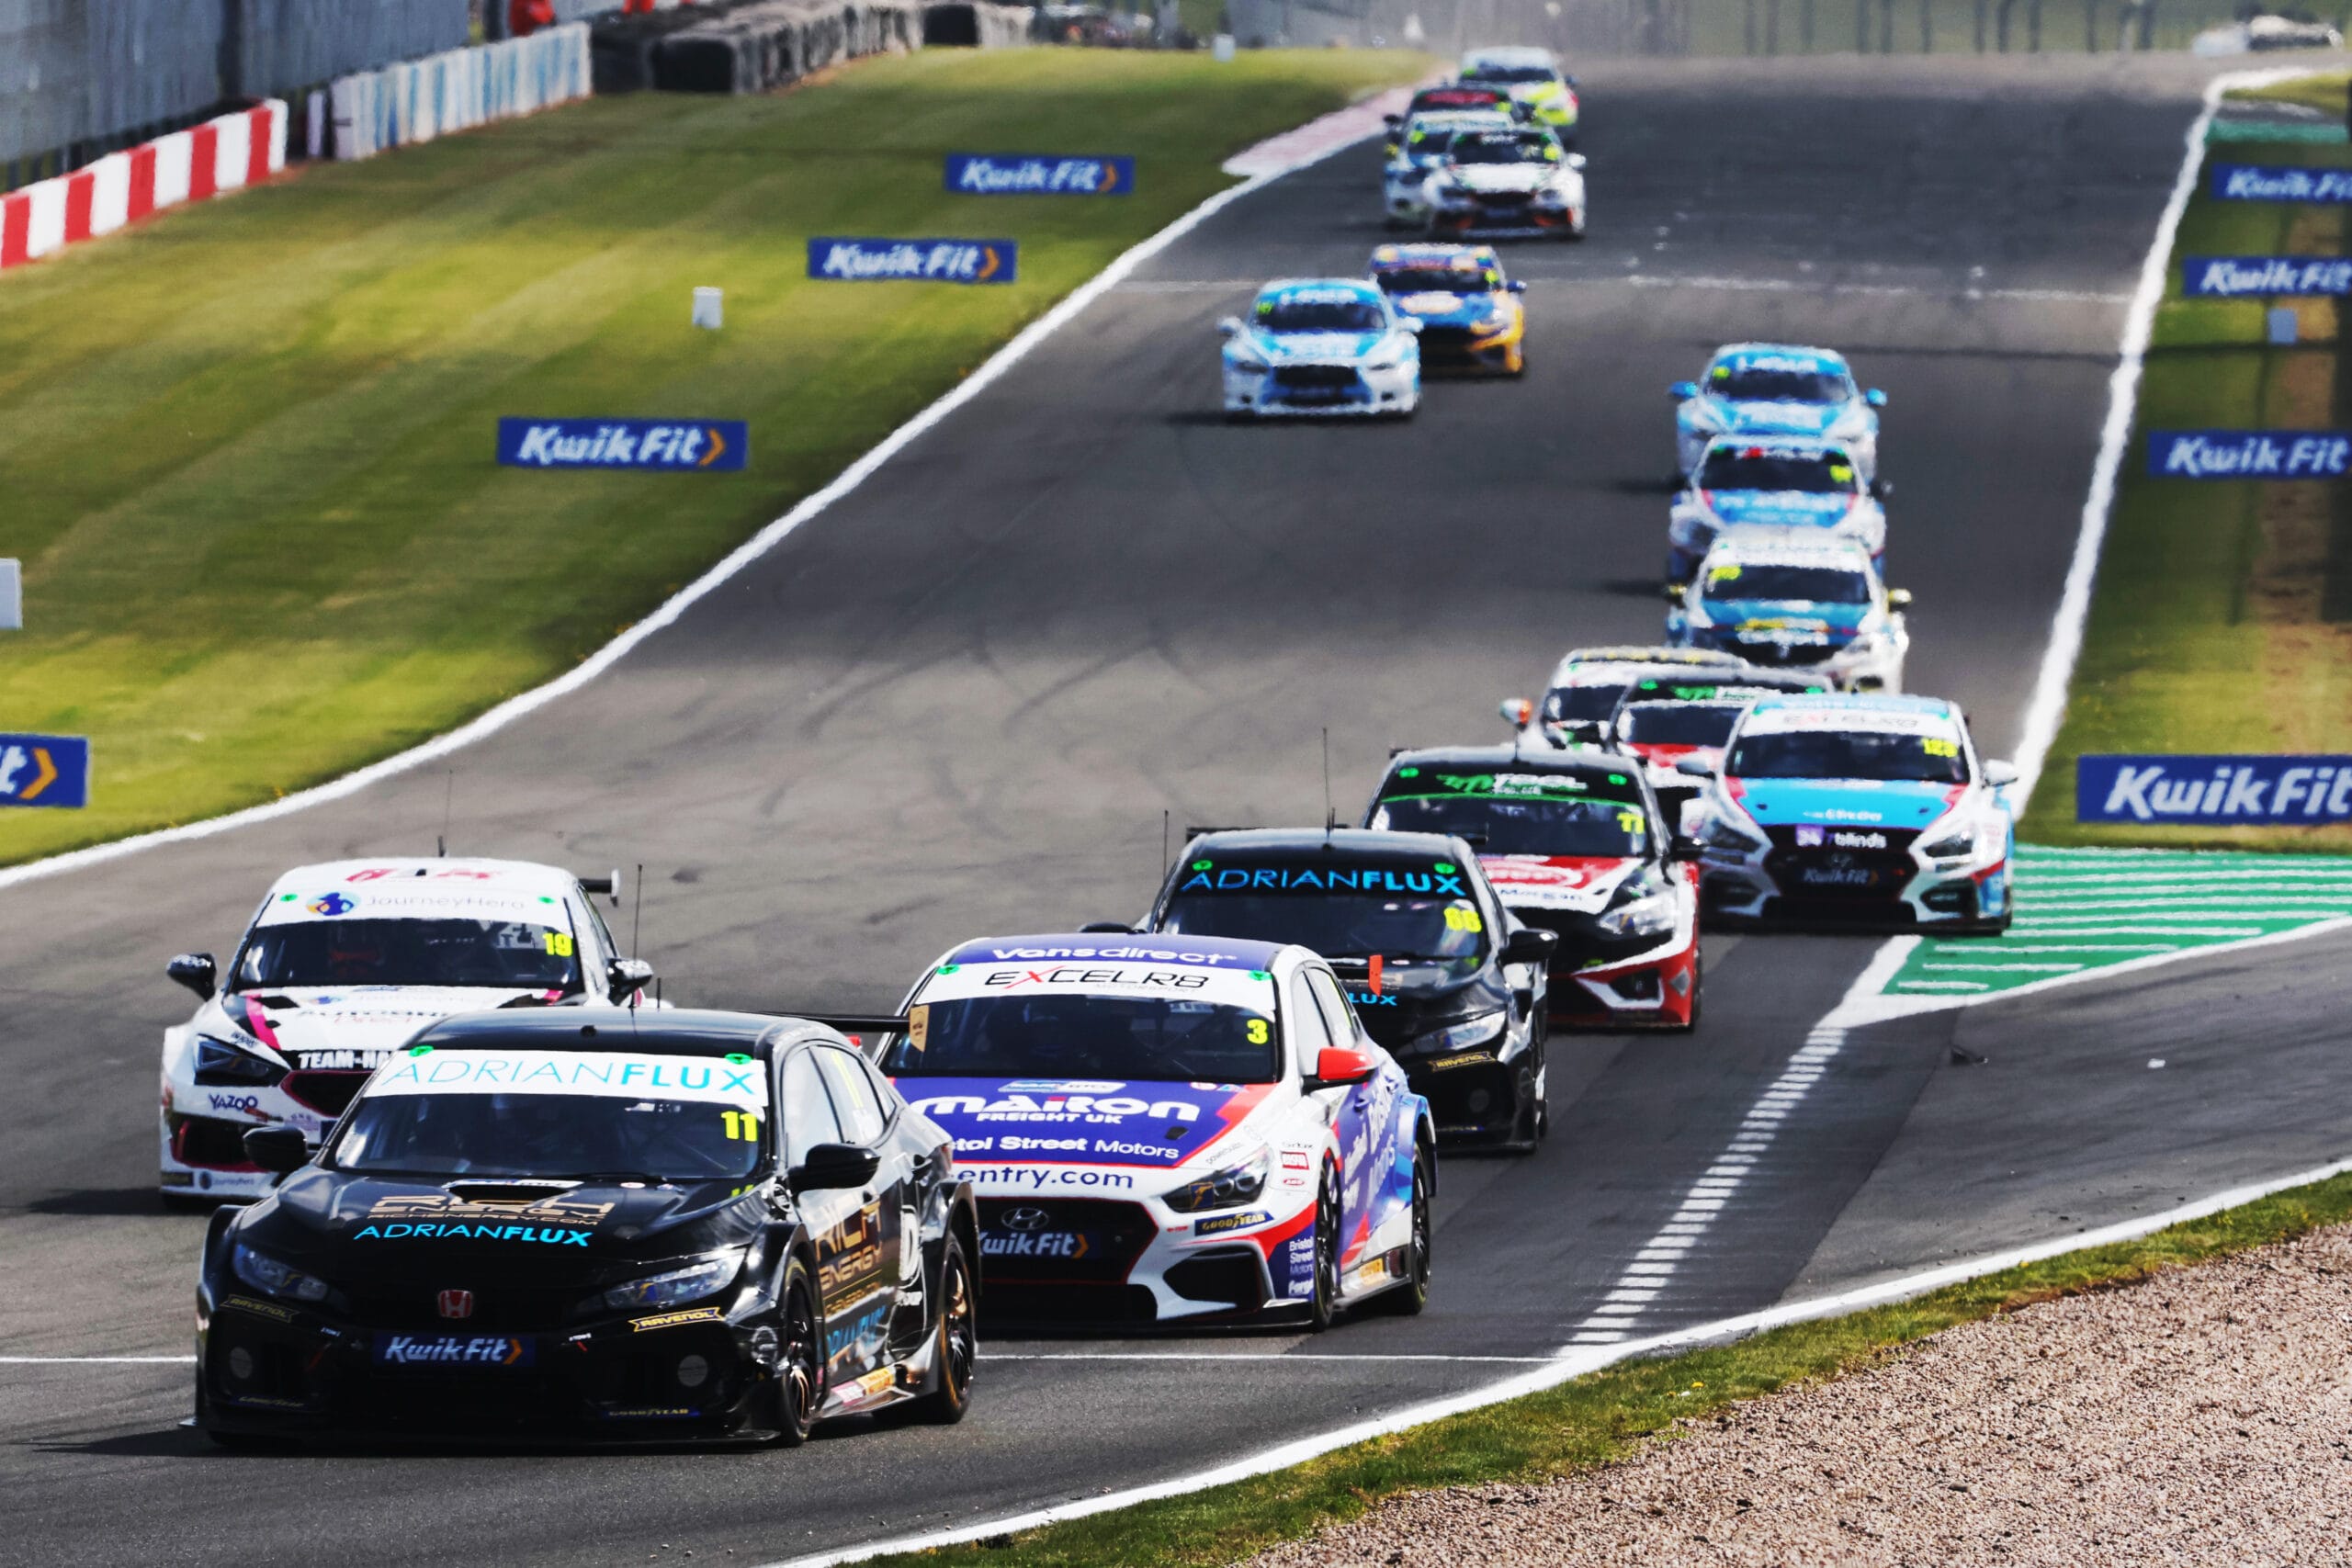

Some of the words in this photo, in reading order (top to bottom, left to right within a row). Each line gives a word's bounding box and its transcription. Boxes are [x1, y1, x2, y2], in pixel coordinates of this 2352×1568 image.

[517, 425, 636, 465] Kwik
[638, 426, 702, 463] Fit
[2165, 435, 2283, 477] Kwik
[2286, 438, 2348, 473] Fit
[2104, 765, 2269, 819] Kwik
[2269, 766, 2352, 815] Fit
[542, 932, 573, 957] 19
[984, 964, 1210, 990] EXCELR8
[1246, 1019, 1269, 1045] 3
[298, 1050, 393, 1070] TEAM-HA
[381, 1059, 755, 1096] ADRIANFLUX
[209, 1093, 260, 1111] YAZOO
[721, 1111, 758, 1142] 11
[976, 1111, 1076, 1122] FREIGHT
[1082, 1113, 1123, 1124] UK
[999, 1137, 1088, 1151] Street
[1094, 1141, 1180, 1158] Motors
[354, 1224, 594, 1247] ADRIANFLUX
[384, 1337, 462, 1363] Kwik
[462, 1337, 507, 1361] Fit
